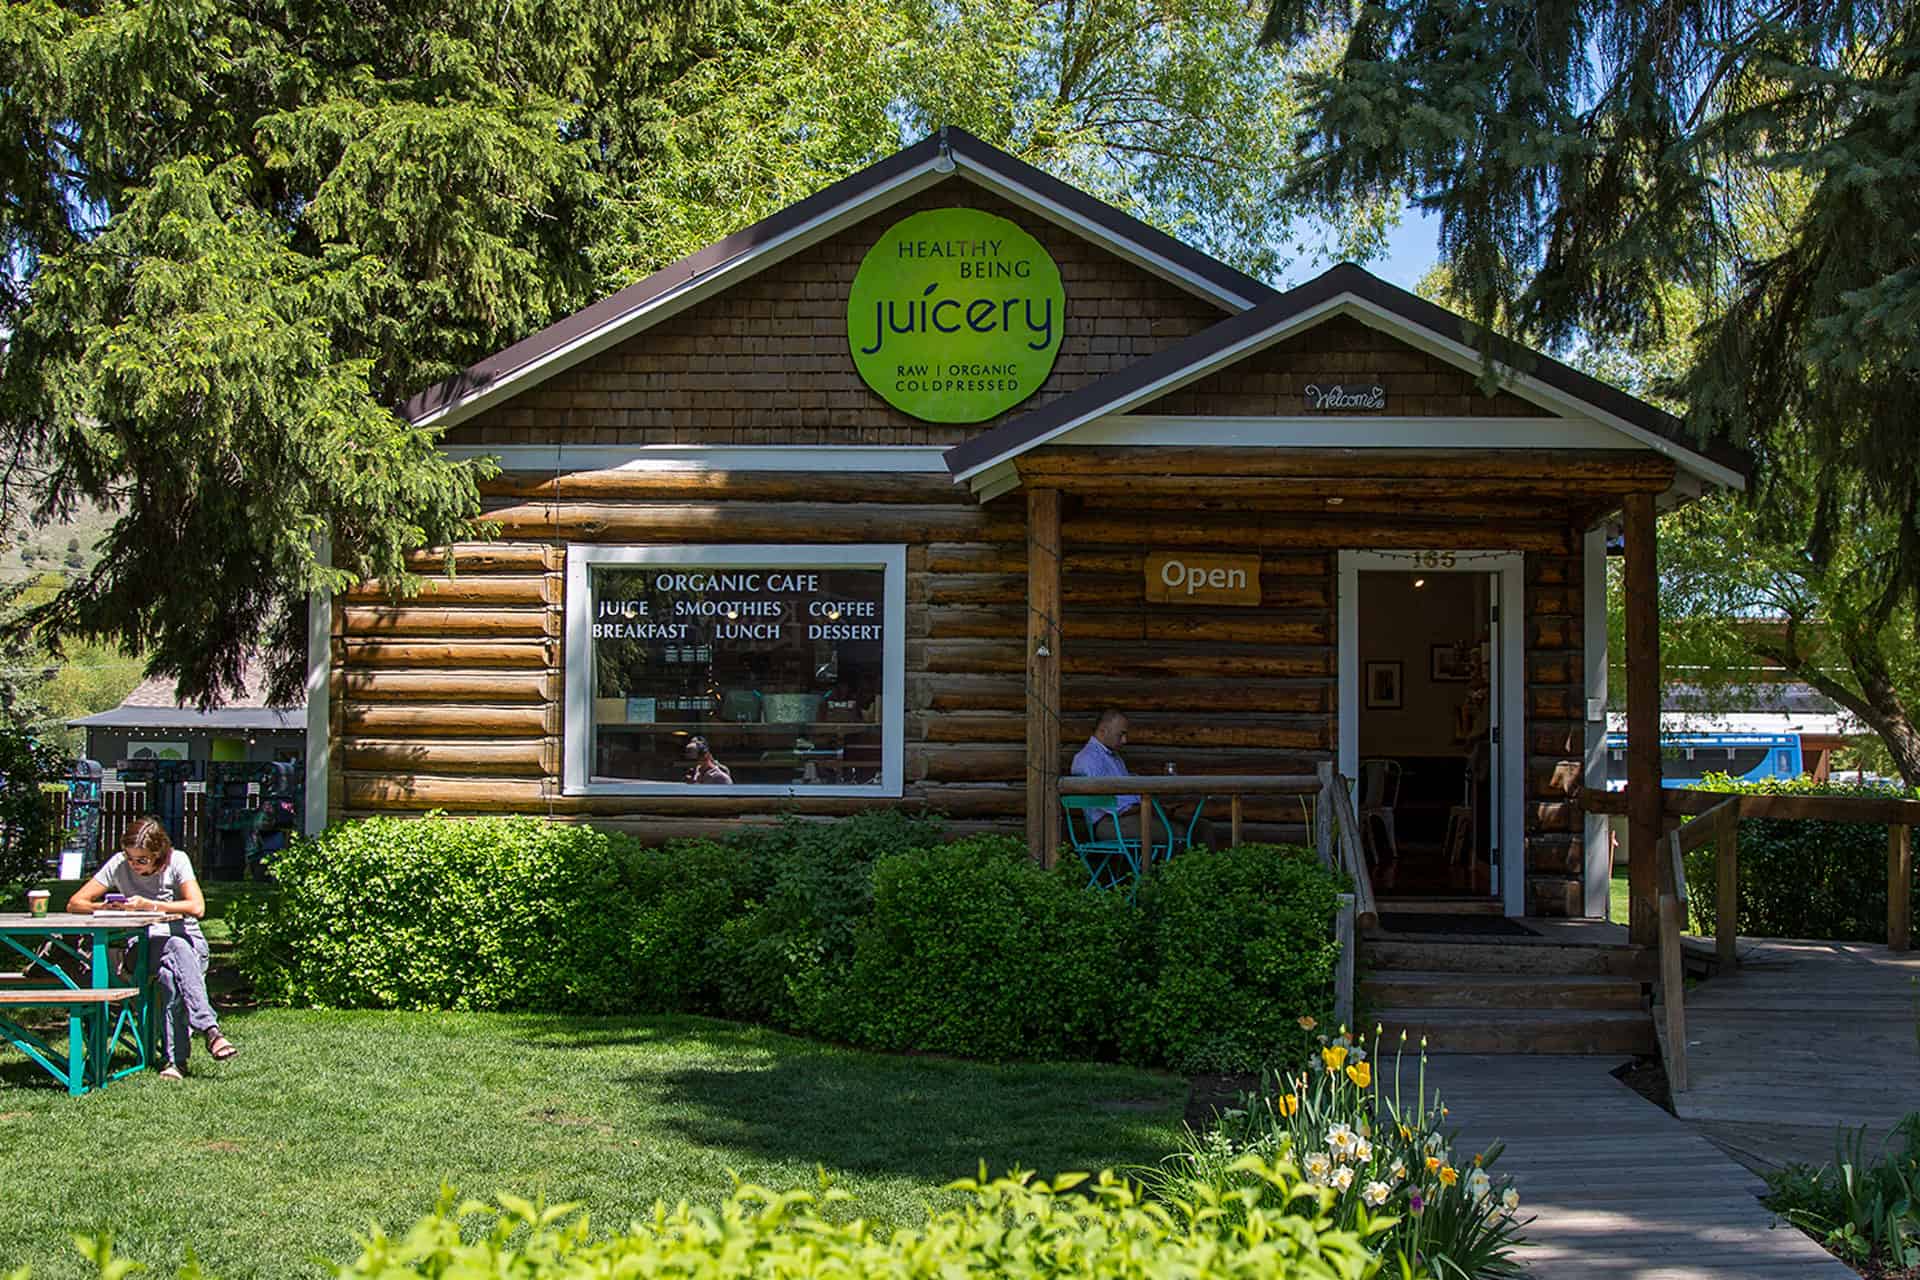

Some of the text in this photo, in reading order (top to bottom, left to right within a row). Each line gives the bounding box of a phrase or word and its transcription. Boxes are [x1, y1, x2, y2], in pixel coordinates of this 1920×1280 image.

[897, 240, 1003, 258] HEALTHY
[960, 260, 1031, 279] BEING
[860, 282, 1052, 355] juicery
[897, 365, 929, 377] RAW
[949, 364, 1018, 377] ORGANIC
[1305, 384, 1381, 410] Welcome
[1411, 549, 1456, 569] 165
[655, 574, 819, 592] ORGANIC CAFE
[1161, 560, 1247, 595] Open
[599, 600, 875, 619] JUICE SMOOTHIES COFFEE
[592, 624, 882, 640] BREAKFAST LUNCH DESSERT
